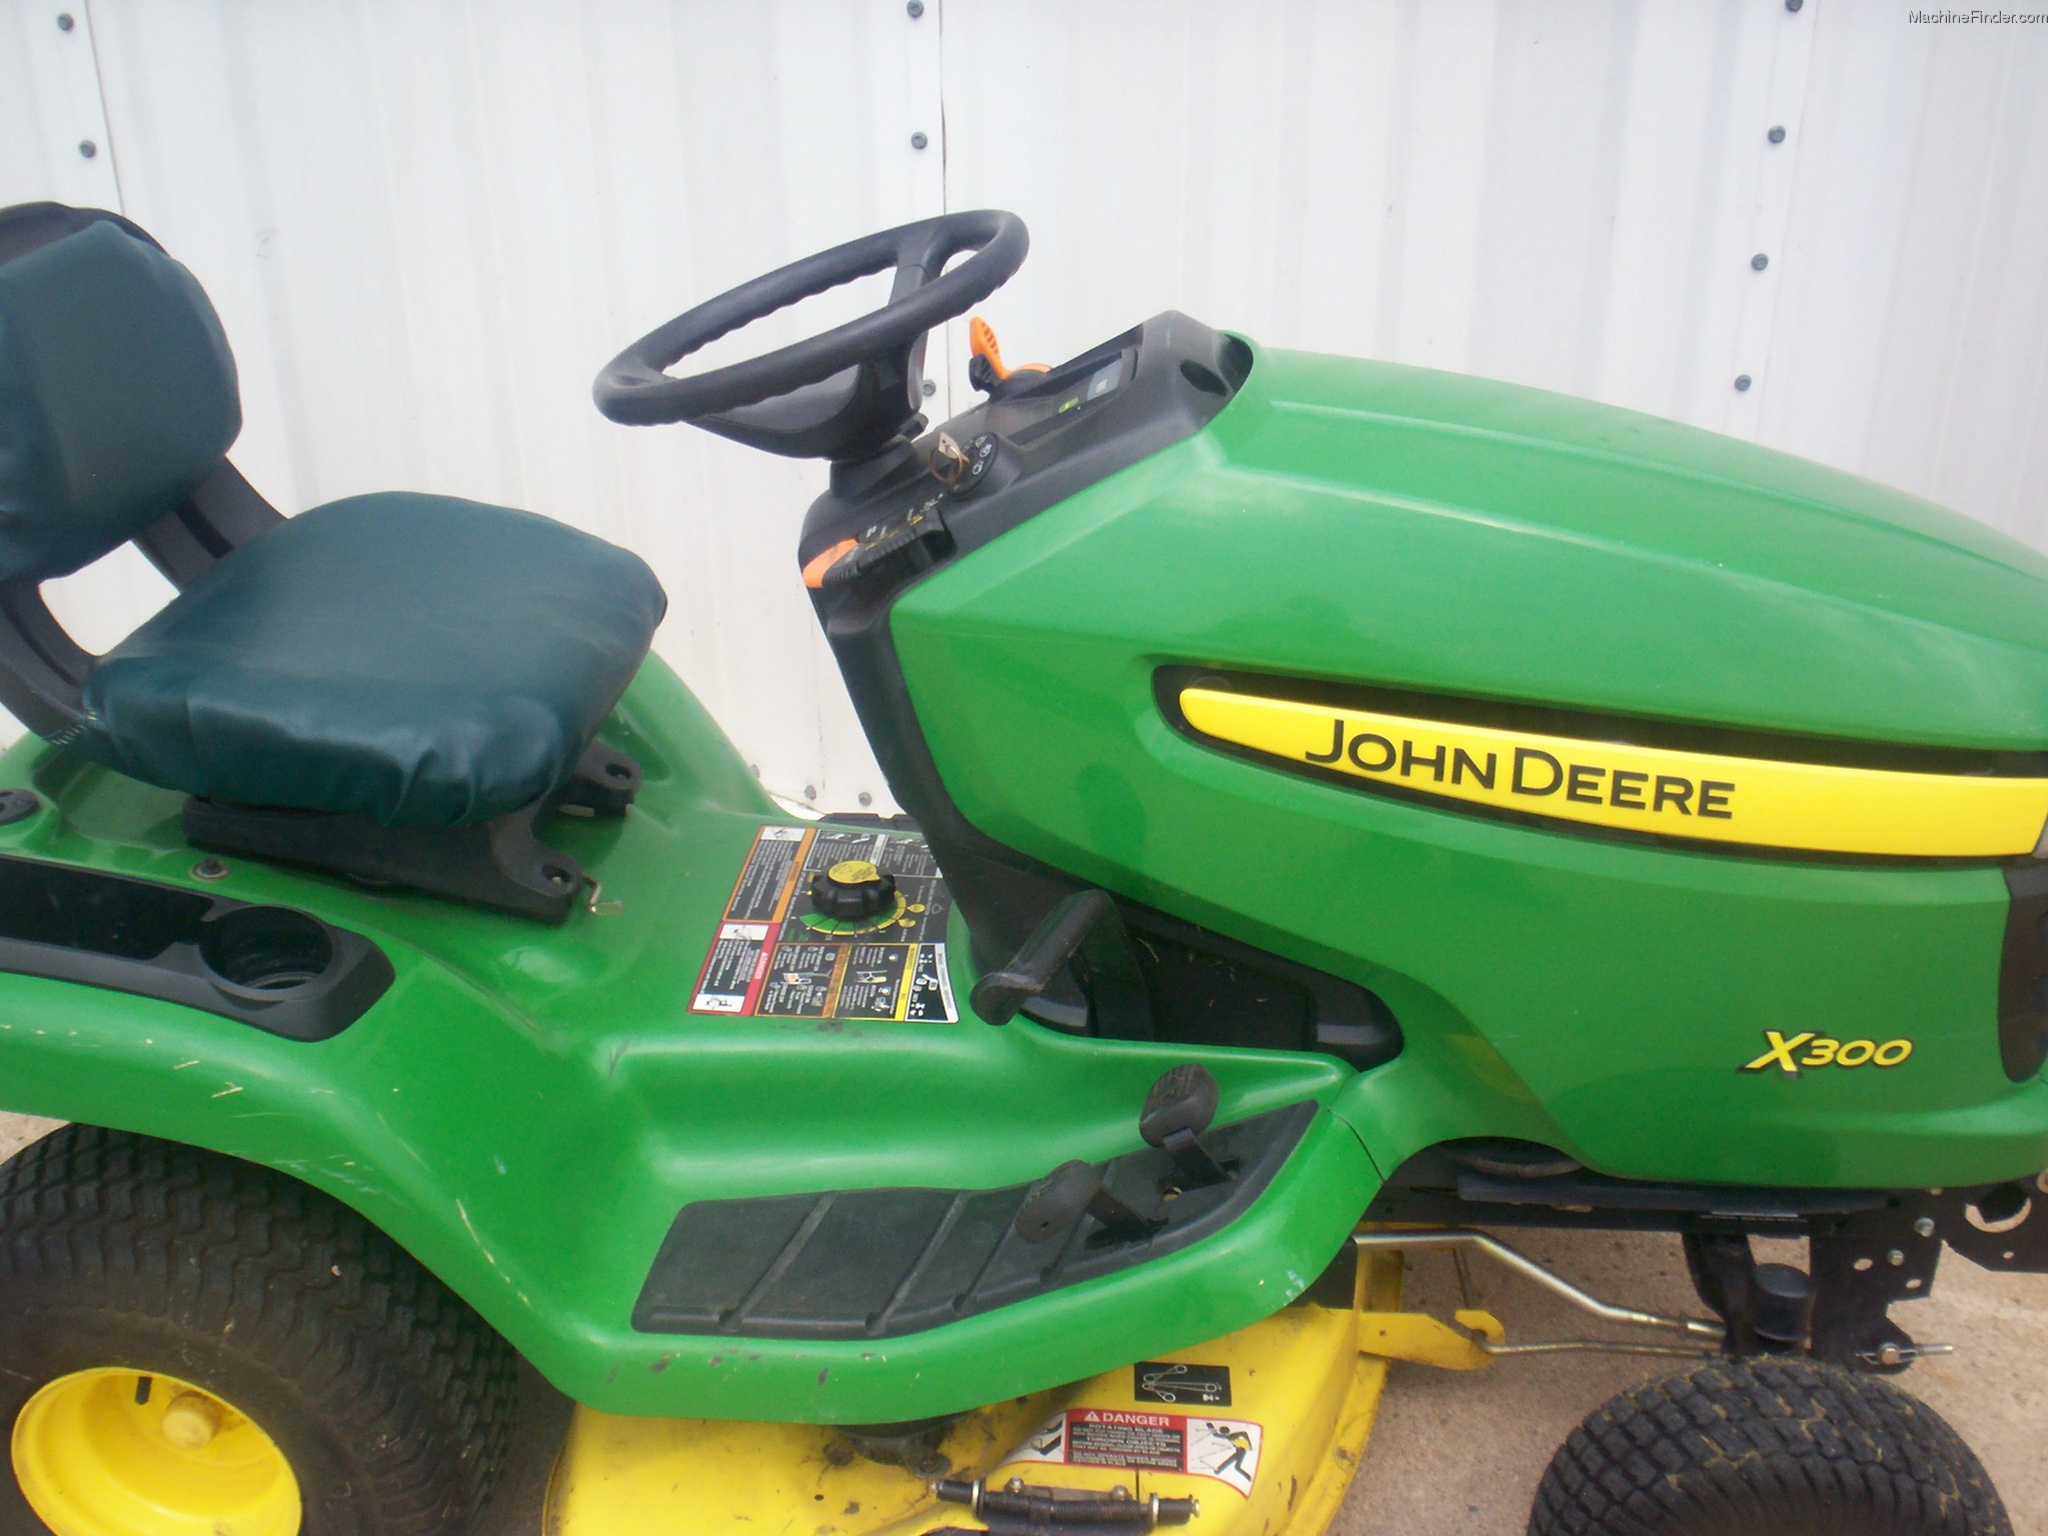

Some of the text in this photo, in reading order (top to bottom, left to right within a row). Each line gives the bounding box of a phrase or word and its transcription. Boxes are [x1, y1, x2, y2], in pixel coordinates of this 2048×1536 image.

[1305, 719, 1736, 819] JOHN DEERE
[1744, 1031, 1913, 1072] X300
[1102, 1412, 1170, 1427] DANGER
